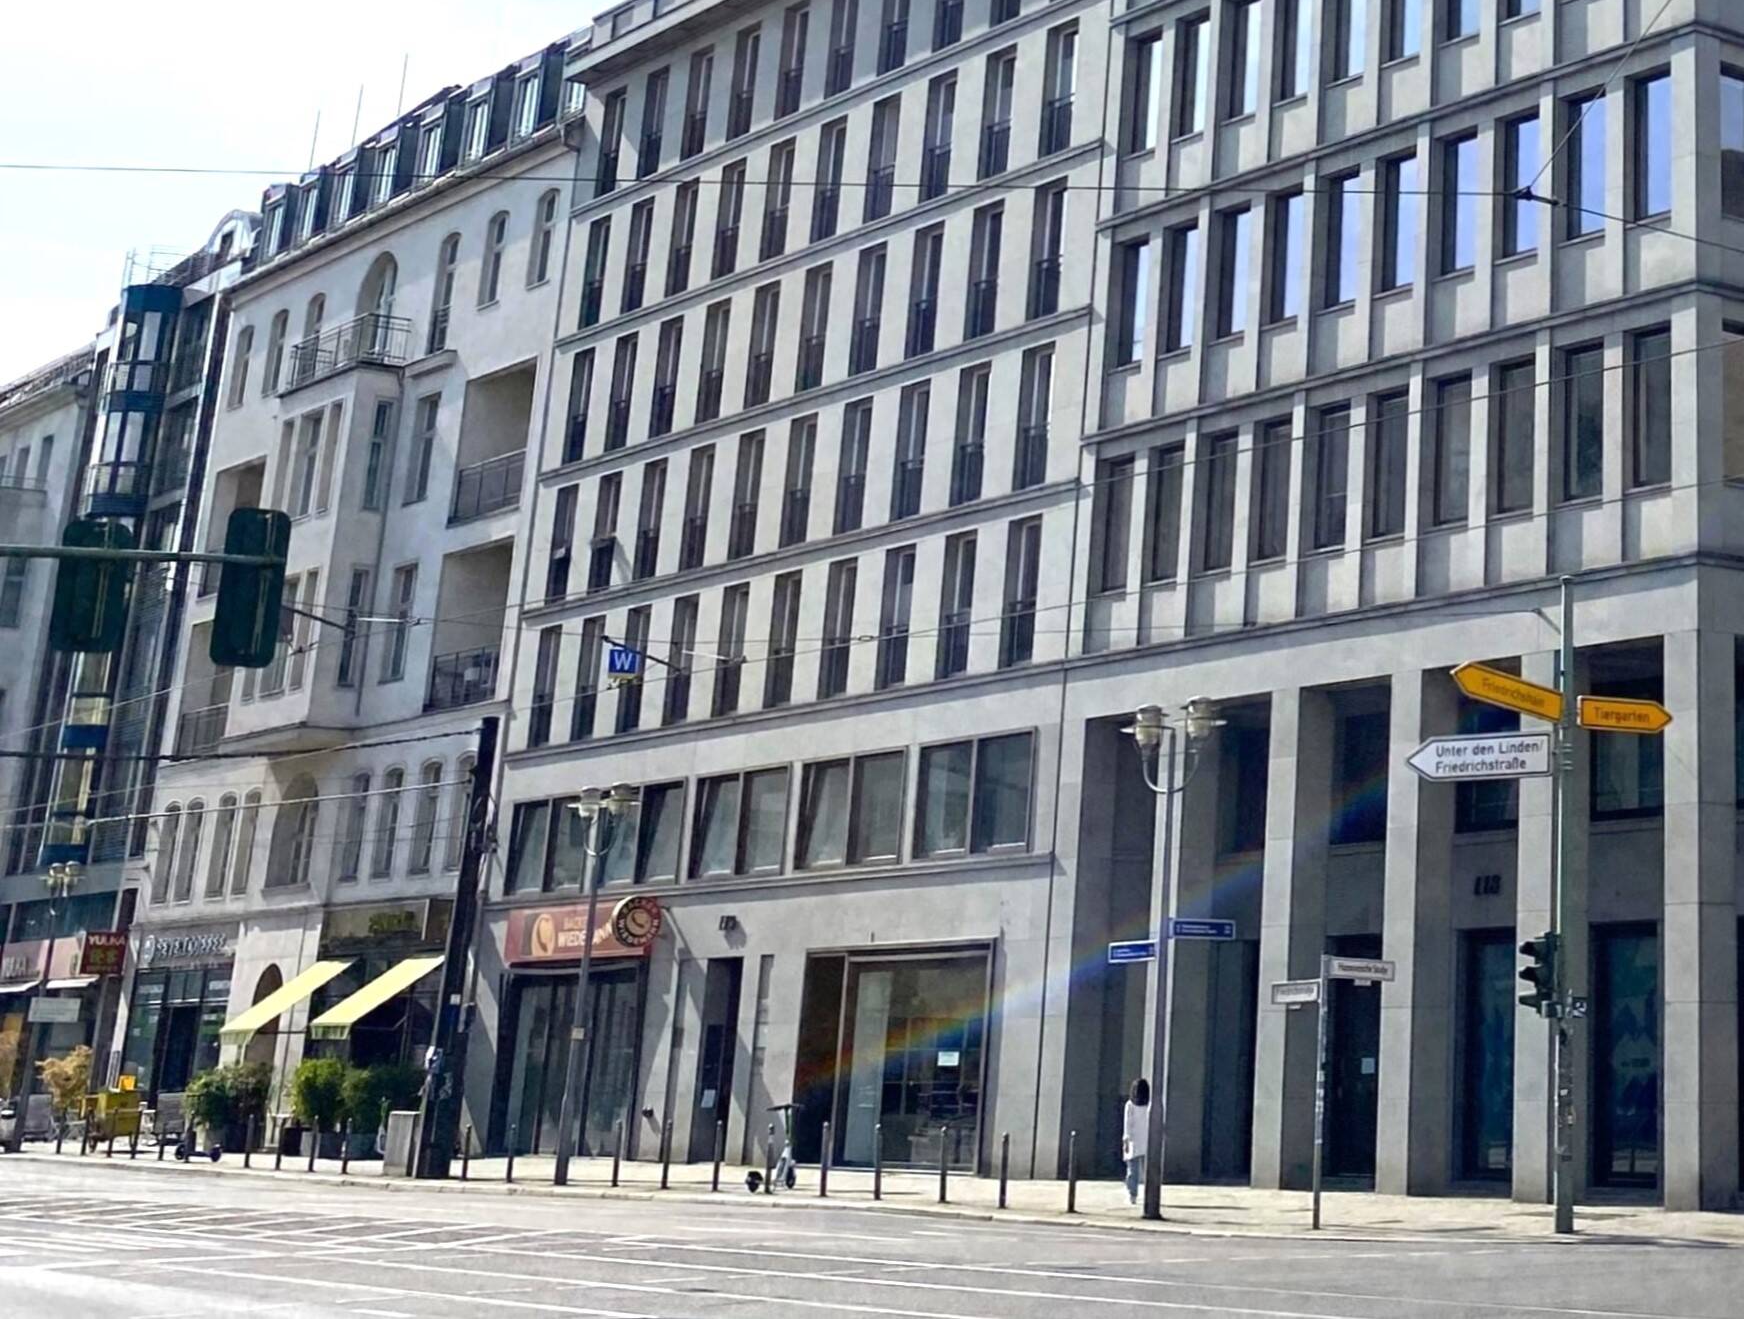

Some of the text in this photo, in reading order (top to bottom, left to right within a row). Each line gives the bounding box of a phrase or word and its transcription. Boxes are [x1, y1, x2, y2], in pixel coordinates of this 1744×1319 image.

[613, 651, 633, 671] W
[1594, 708, 1650, 723] Tiergarten
[1436, 739, 1544, 758] Unter den Linden/
[1435, 758, 1527, 774] Friedrichstraße
[88, 934, 126, 946] YULKA
